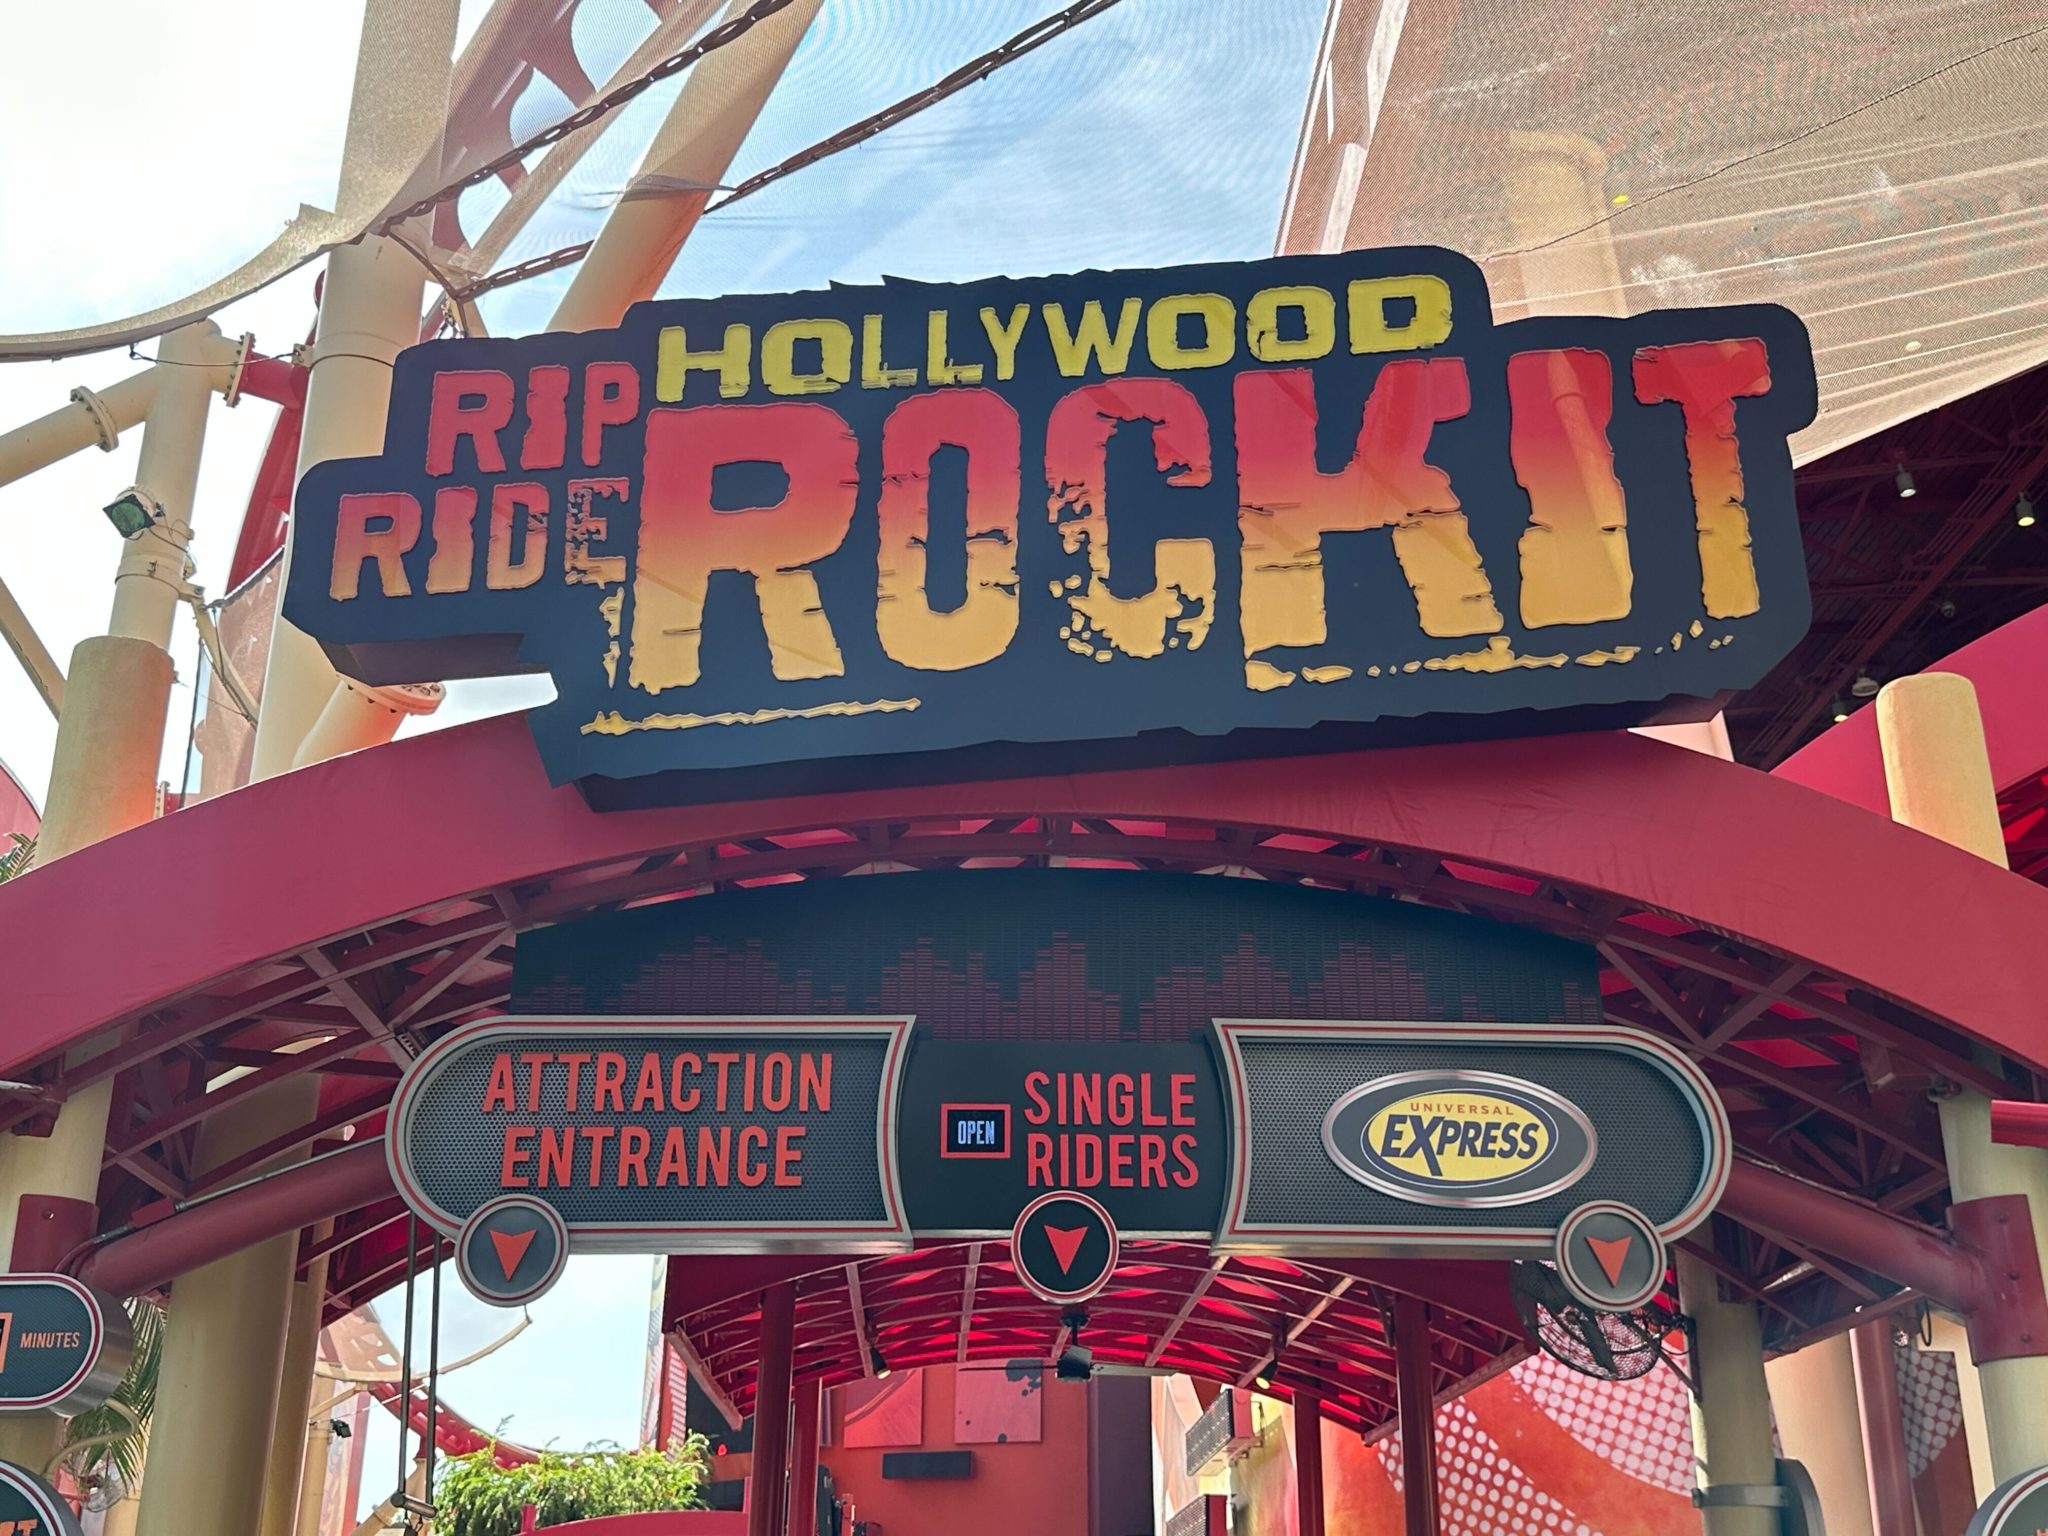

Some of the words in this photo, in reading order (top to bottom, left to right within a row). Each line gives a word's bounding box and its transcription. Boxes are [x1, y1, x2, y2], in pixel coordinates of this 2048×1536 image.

[655, 274, 1453, 402] HOLLYWOOD
[425, 361, 640, 477] RIP
[329, 477, 630, 602] RIDE
[629, 336, 1773, 695] ROCKIT
[481, 1053, 833, 1113] ATTRACTION
[1023, 1071, 1197, 1127] SINGLE
[1410, 1101, 1515, 1116] UNIVERSAL
[501, 1126, 807, 1188] ENTRANCE
[957, 1119, 996, 1146] OPEN
[1026, 1133, 1200, 1188] RIDERS
[1380, 1113, 1542, 1177] EXPRESS
[20, 1331, 80, 1348] MINUTES
